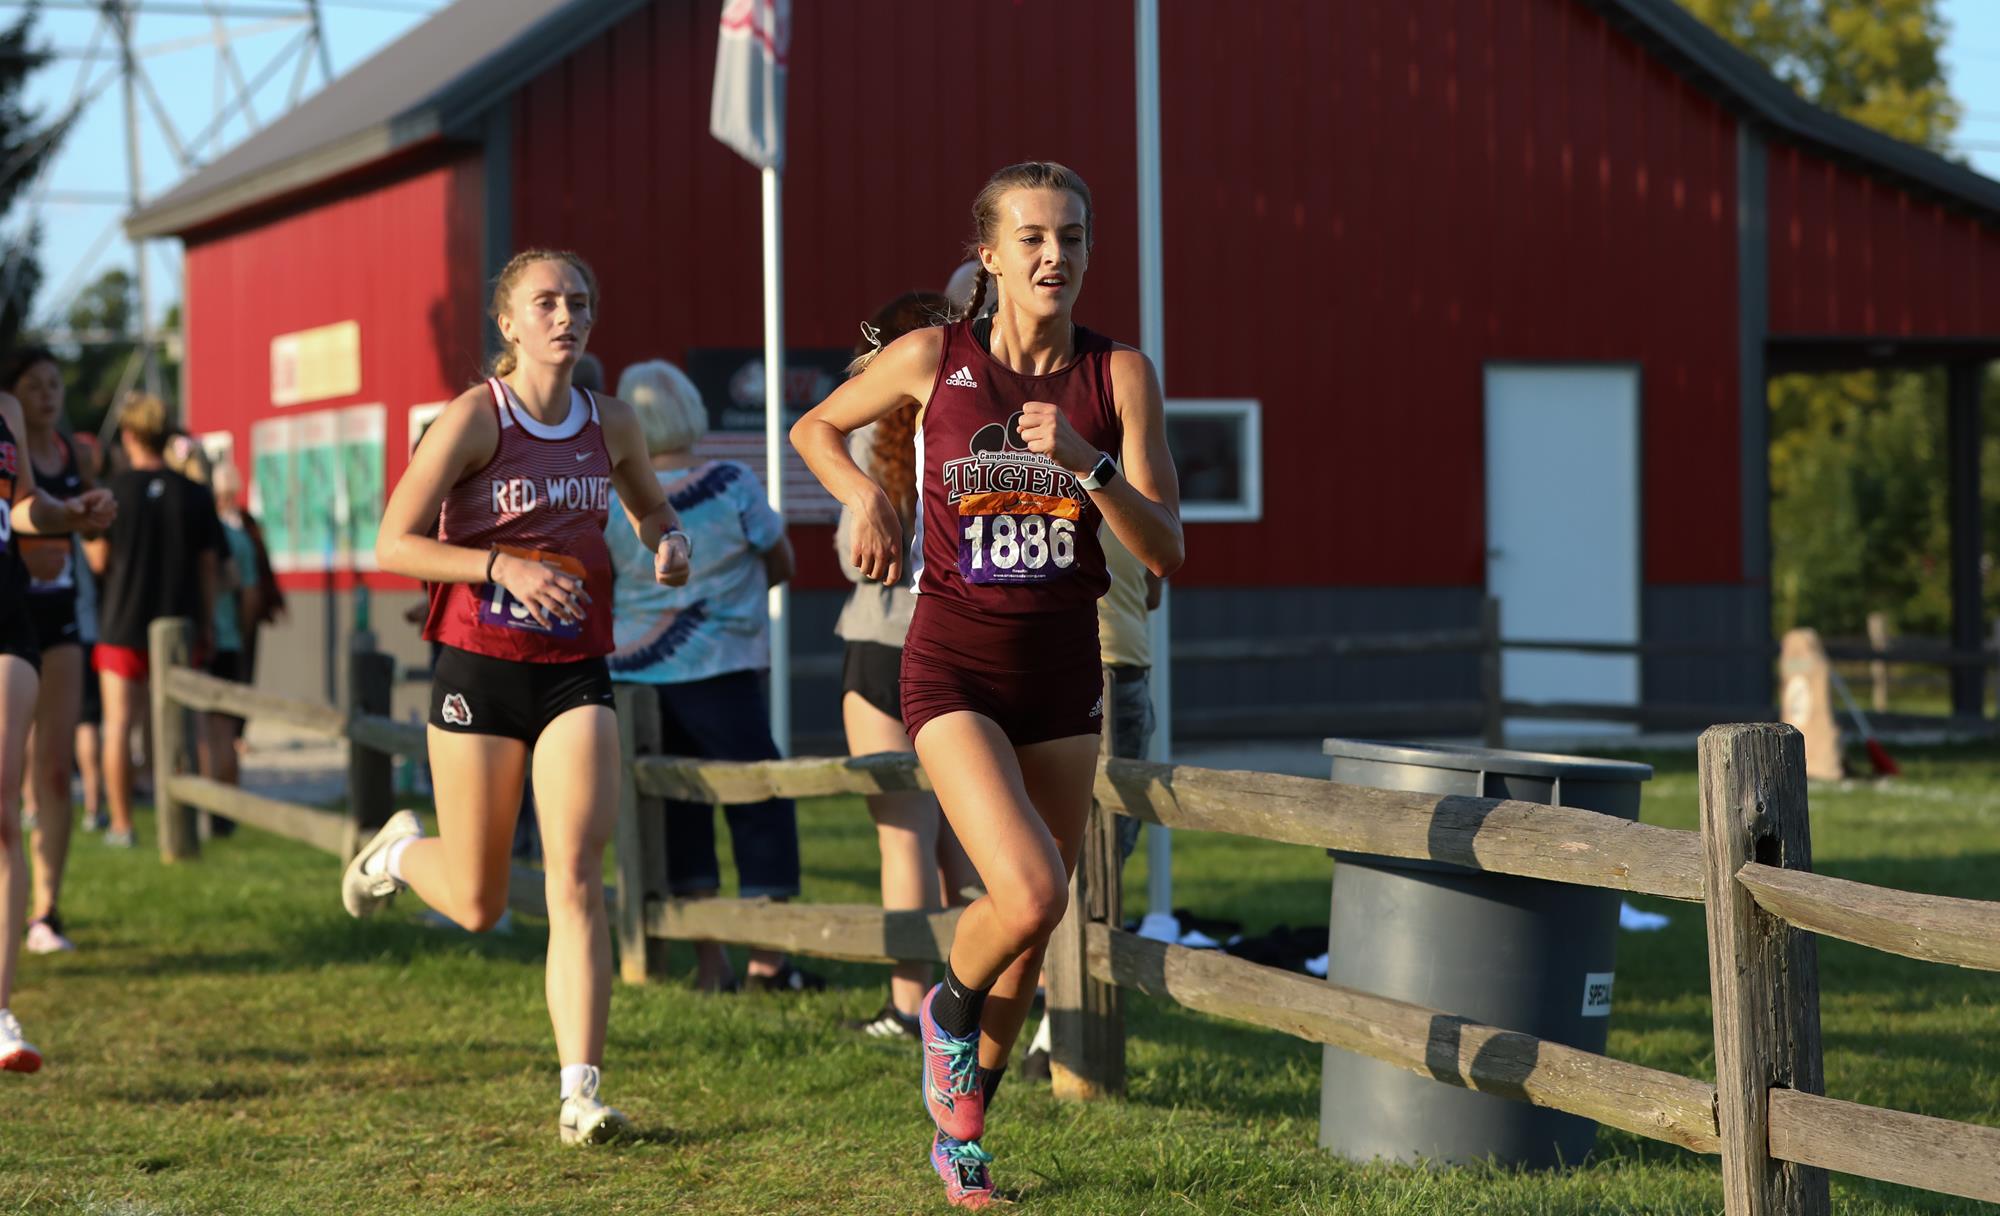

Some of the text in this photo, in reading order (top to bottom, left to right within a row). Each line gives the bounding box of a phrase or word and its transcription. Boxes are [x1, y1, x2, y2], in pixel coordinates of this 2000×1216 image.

[945, 377, 978, 388] adidas
[979, 452, 1059, 467] Campbellsville Univ
[491, 477, 610, 513] RED WOLVE
[965, 515, 1076, 569] 1886
